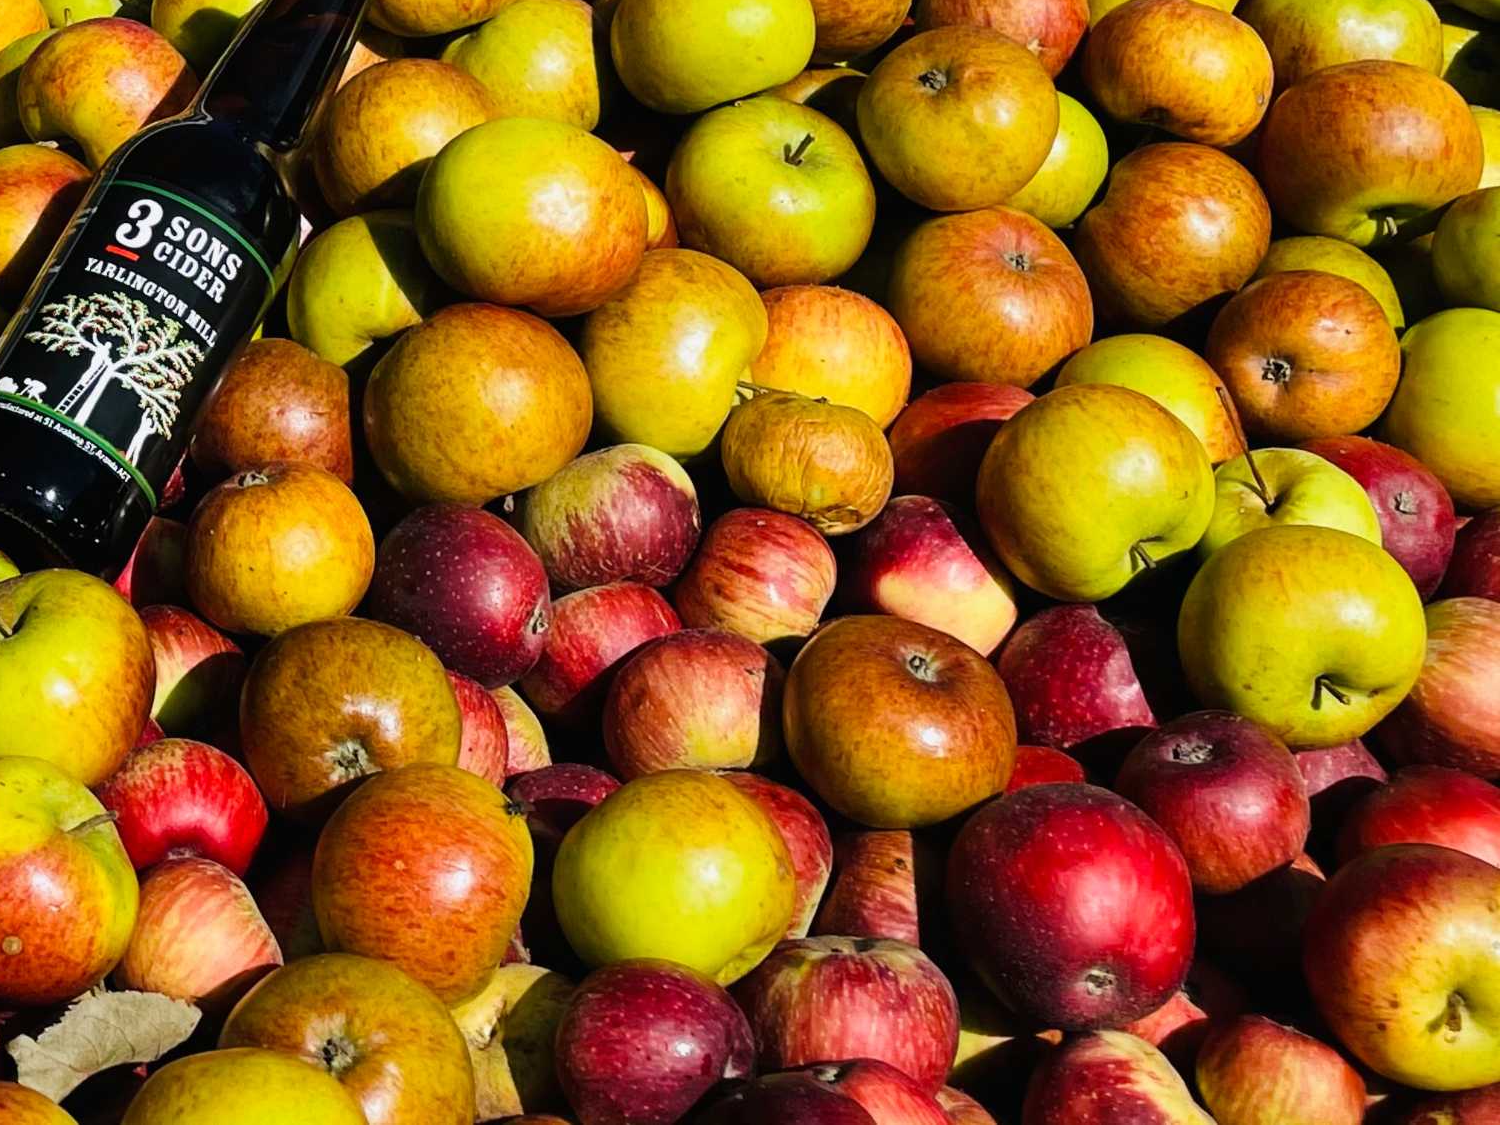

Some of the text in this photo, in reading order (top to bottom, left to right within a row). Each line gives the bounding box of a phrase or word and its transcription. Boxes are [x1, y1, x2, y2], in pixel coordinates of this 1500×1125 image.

[115, 198, 164, 249] 3
[164, 216, 243, 281] SONS
[152, 241, 227, 304] CIDER
[84, 257, 218, 348] YARLINGTON MILL
